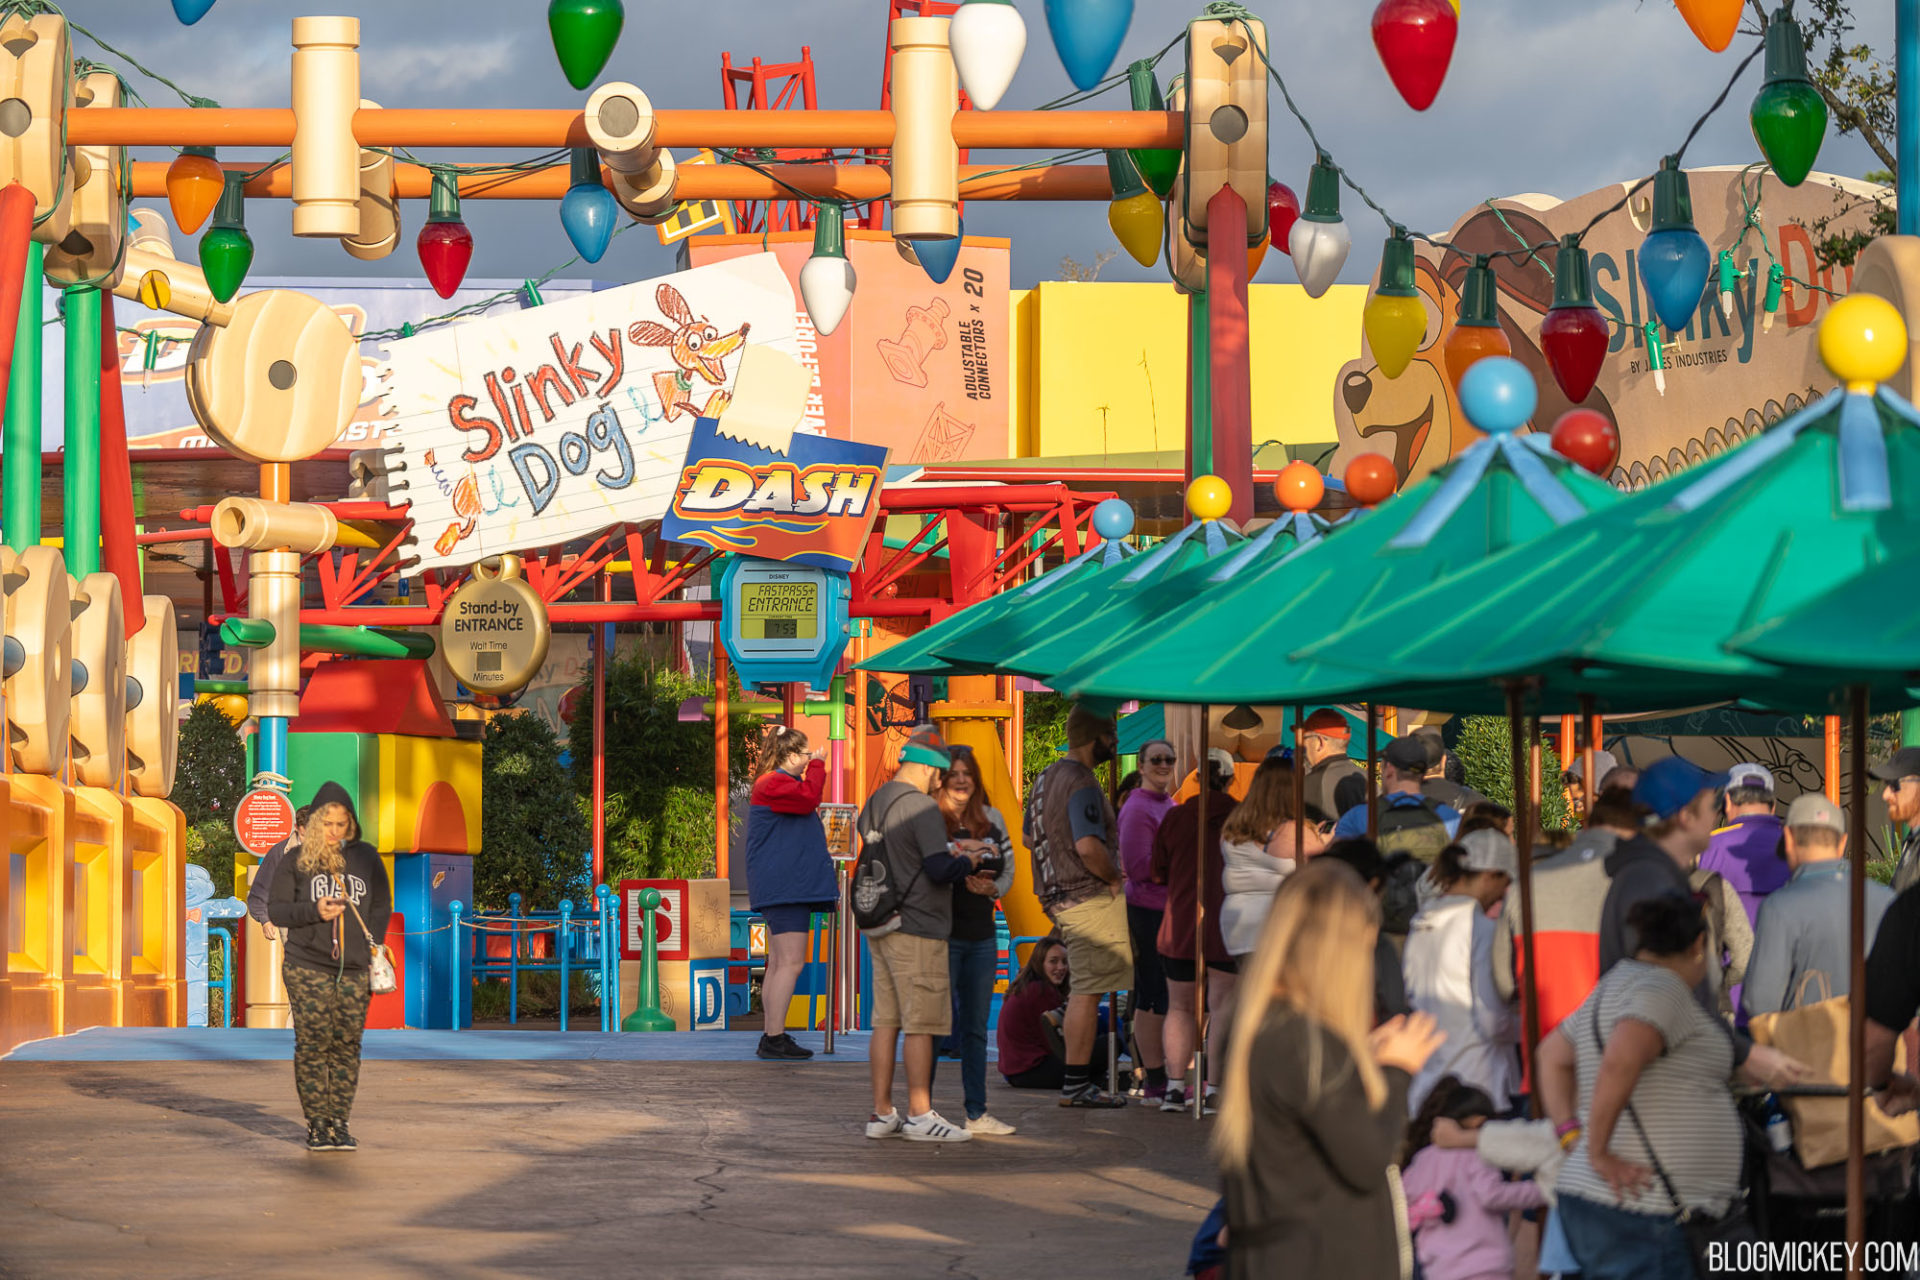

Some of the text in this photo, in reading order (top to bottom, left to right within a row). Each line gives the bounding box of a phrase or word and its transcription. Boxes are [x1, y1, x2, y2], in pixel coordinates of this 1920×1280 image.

[963, 267, 984, 298] 20
[971, 319, 992, 400] CONNECTORS
[1630, 349, 1729, 374] BY JES INDUSTRIES
[448, 328, 625, 463] Slinky
[508, 402, 637, 517] Dog
[679, 466, 877, 517] DASH
[758, 585, 815, 596] FASTPASS+
[459, 600, 520, 616] Stand-by
[747, 597, 814, 612] ENTRANCE
[454, 618, 524, 632] ENTRANCE
[470, 640, 508, 650] Wait Time
[473, 673, 505, 682] Minutes
[311, 873, 367, 906] GAP
[750, 927, 764, 948] K
[697, 976, 723, 1024] D
